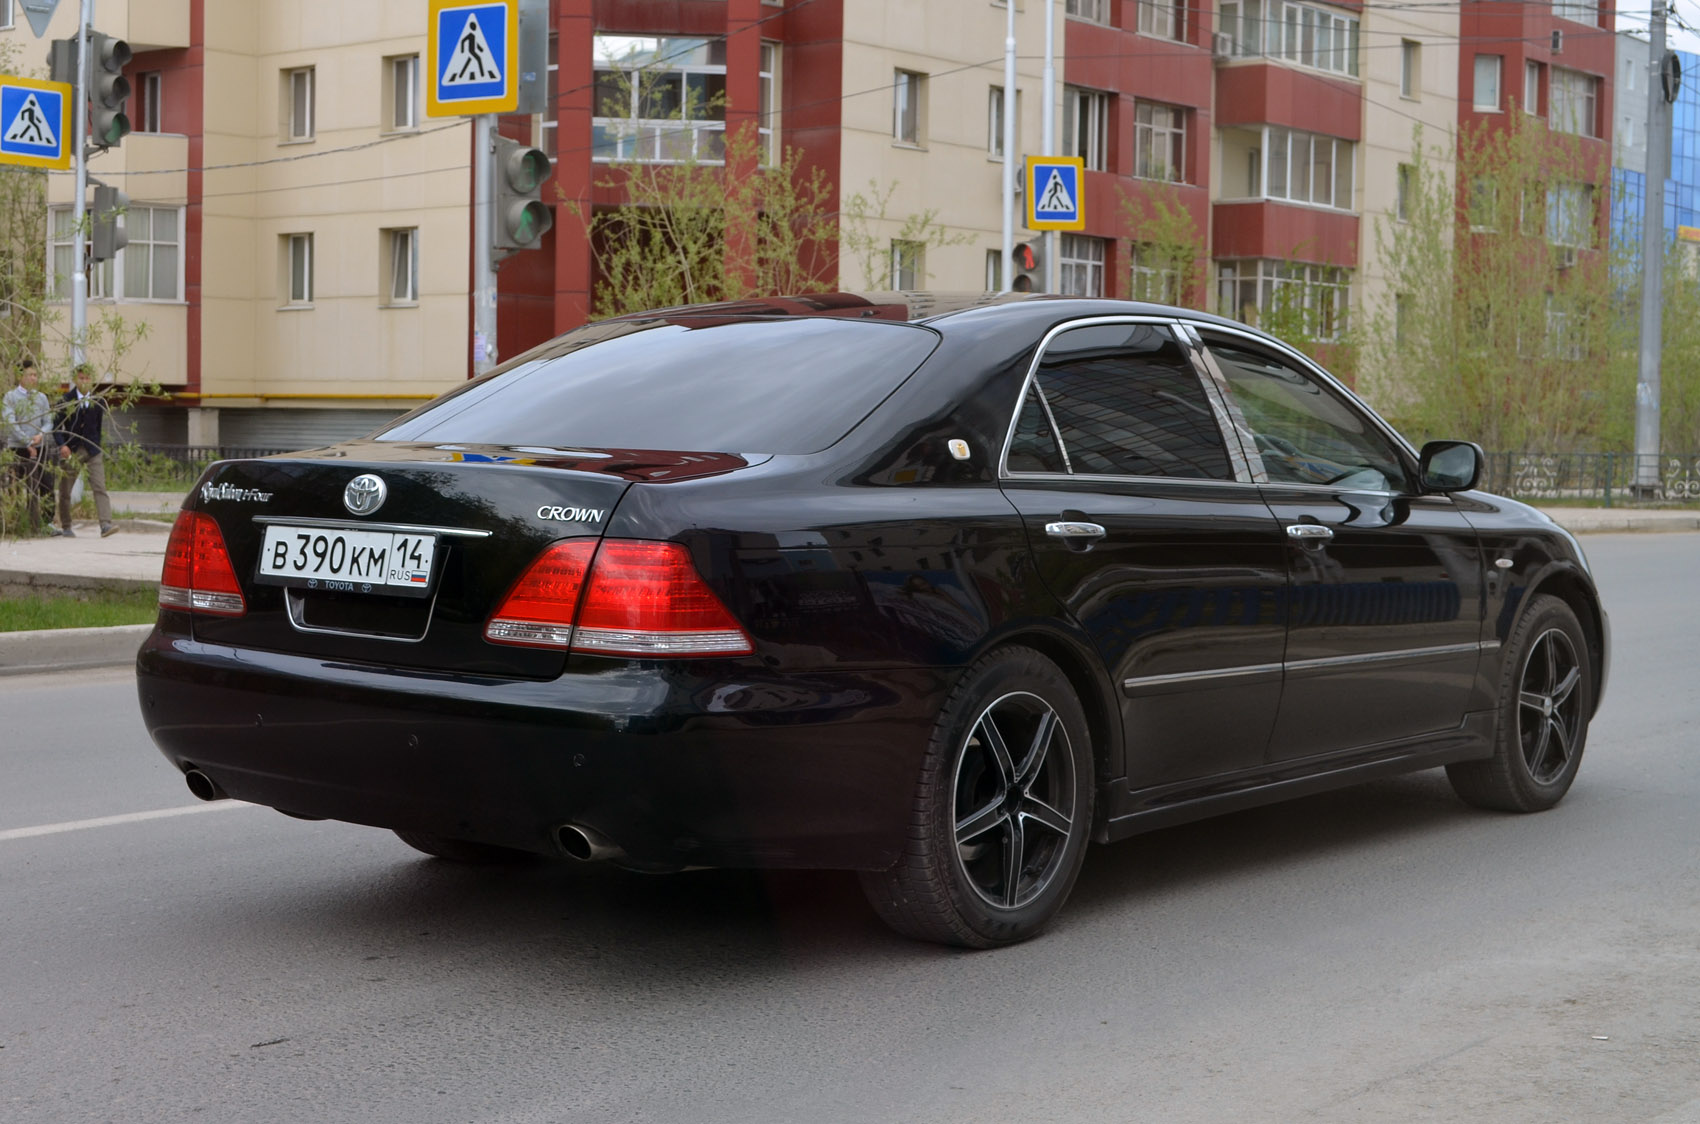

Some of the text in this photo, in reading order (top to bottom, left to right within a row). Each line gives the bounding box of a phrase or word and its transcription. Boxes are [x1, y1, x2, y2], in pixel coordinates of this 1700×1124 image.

[537, 505, 605, 523] CROWN
[397, 538, 422, 569] 14
[389, 570, 411, 581] RUS
[325, 581, 354, 592] TOYOTA
